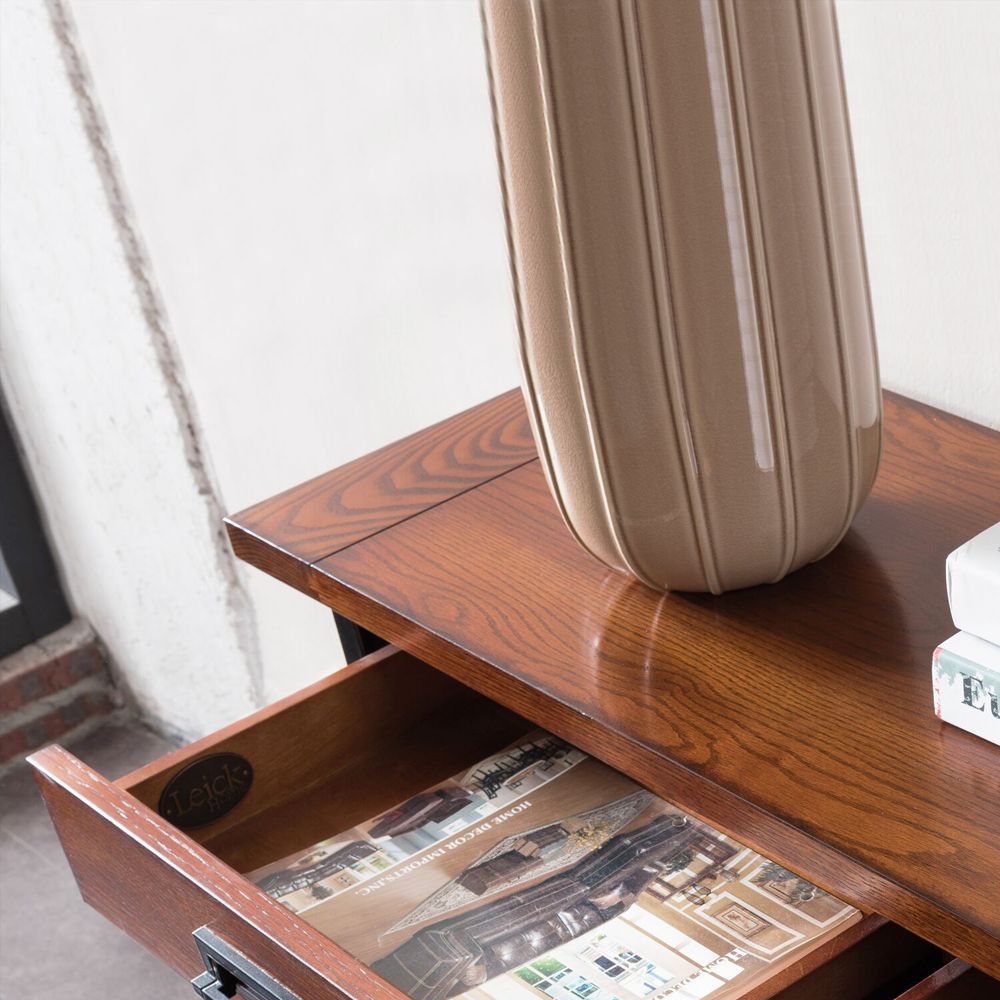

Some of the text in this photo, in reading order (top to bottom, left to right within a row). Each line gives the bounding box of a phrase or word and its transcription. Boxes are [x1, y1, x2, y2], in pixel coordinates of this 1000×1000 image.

[169, 764, 245, 816] Leick
[495, 800, 532, 826] HOME
[448, 823, 492, 851] DECOR
